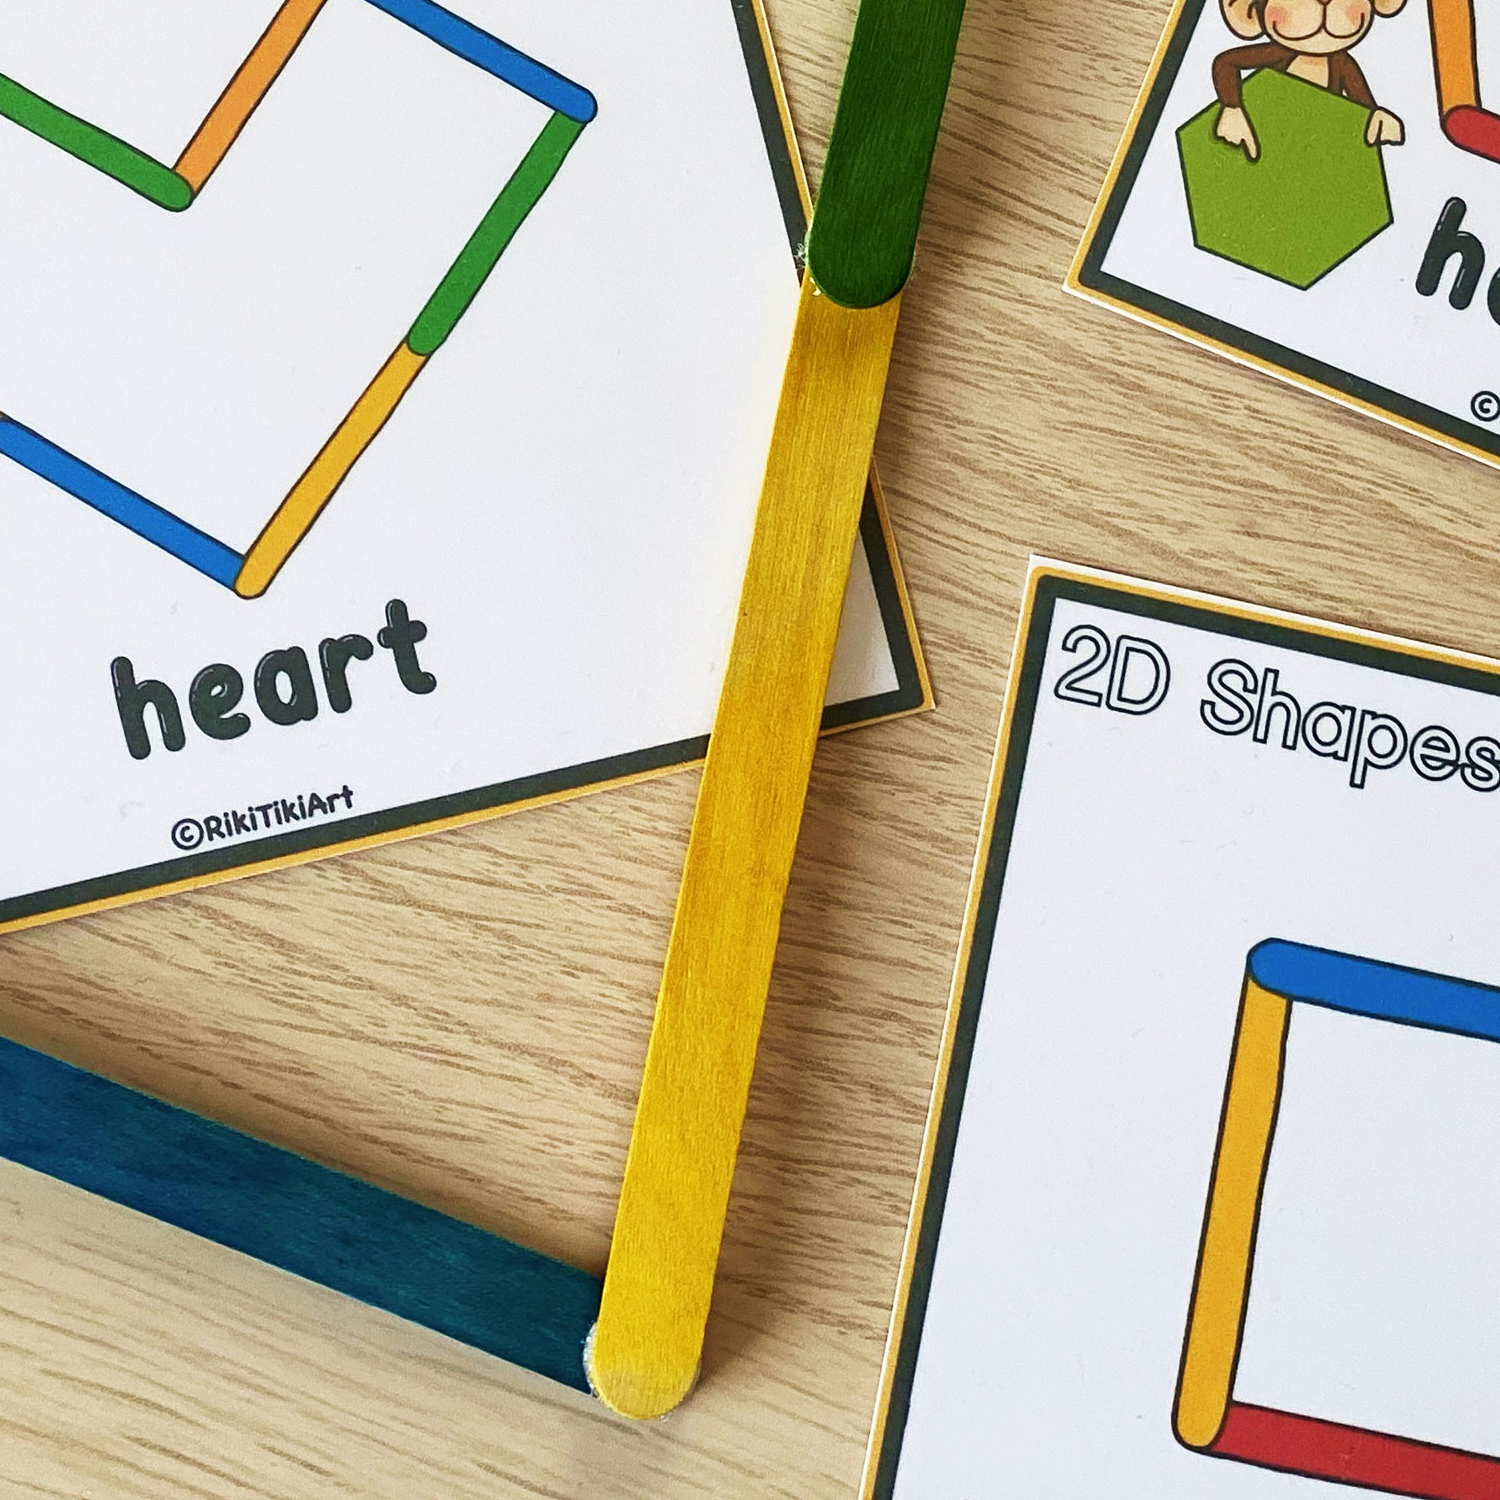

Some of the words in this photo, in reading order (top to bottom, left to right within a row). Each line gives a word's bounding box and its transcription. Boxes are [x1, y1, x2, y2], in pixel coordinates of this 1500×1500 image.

[1415, 196, 1500, 327] h
[110, 598, 437, 760] heart
[1054, 624, 1171, 716] 2D
[1200, 658, 1500, 793] Shapes
